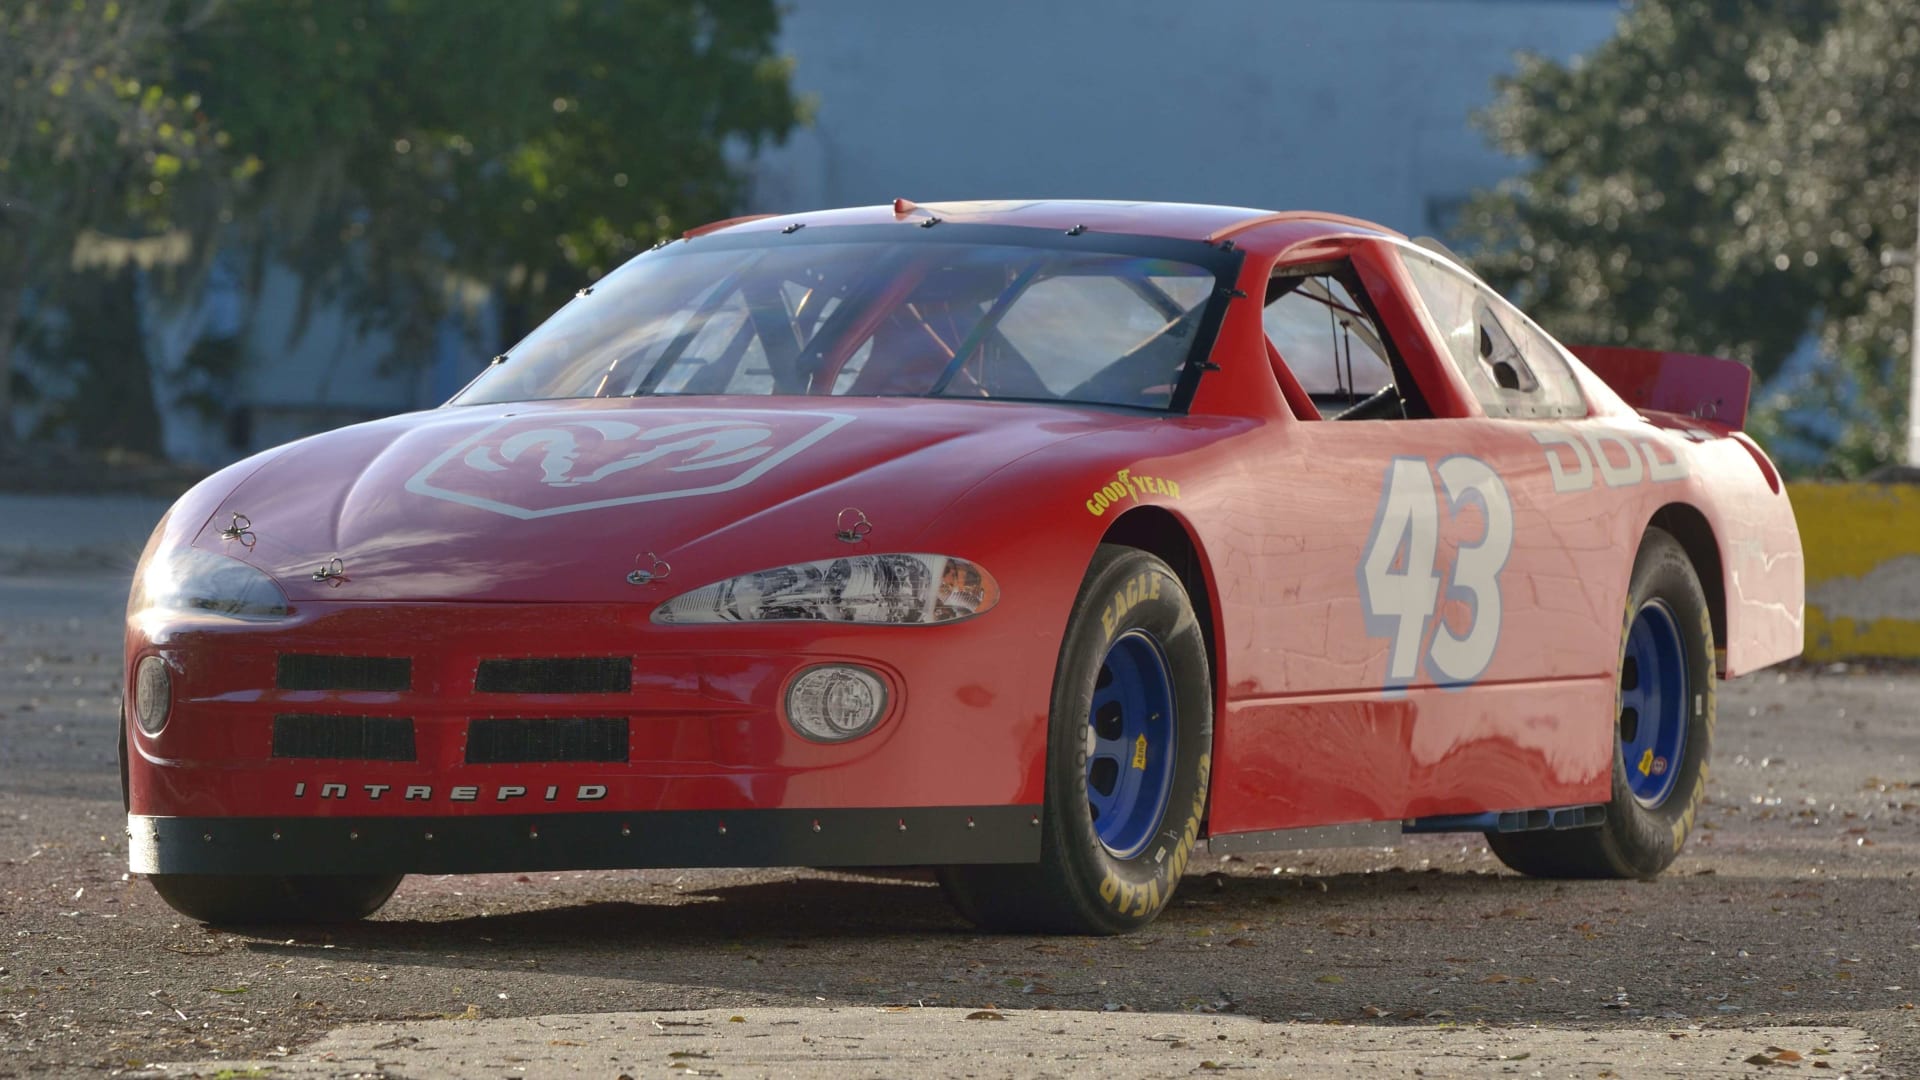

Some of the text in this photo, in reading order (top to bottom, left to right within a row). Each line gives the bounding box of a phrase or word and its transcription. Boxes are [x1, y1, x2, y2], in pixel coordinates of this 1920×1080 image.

[1102, 571, 1162, 642] EAGLE
[1358, 455, 1514, 690] 43
[294, 782, 608, 801] INTREPID
